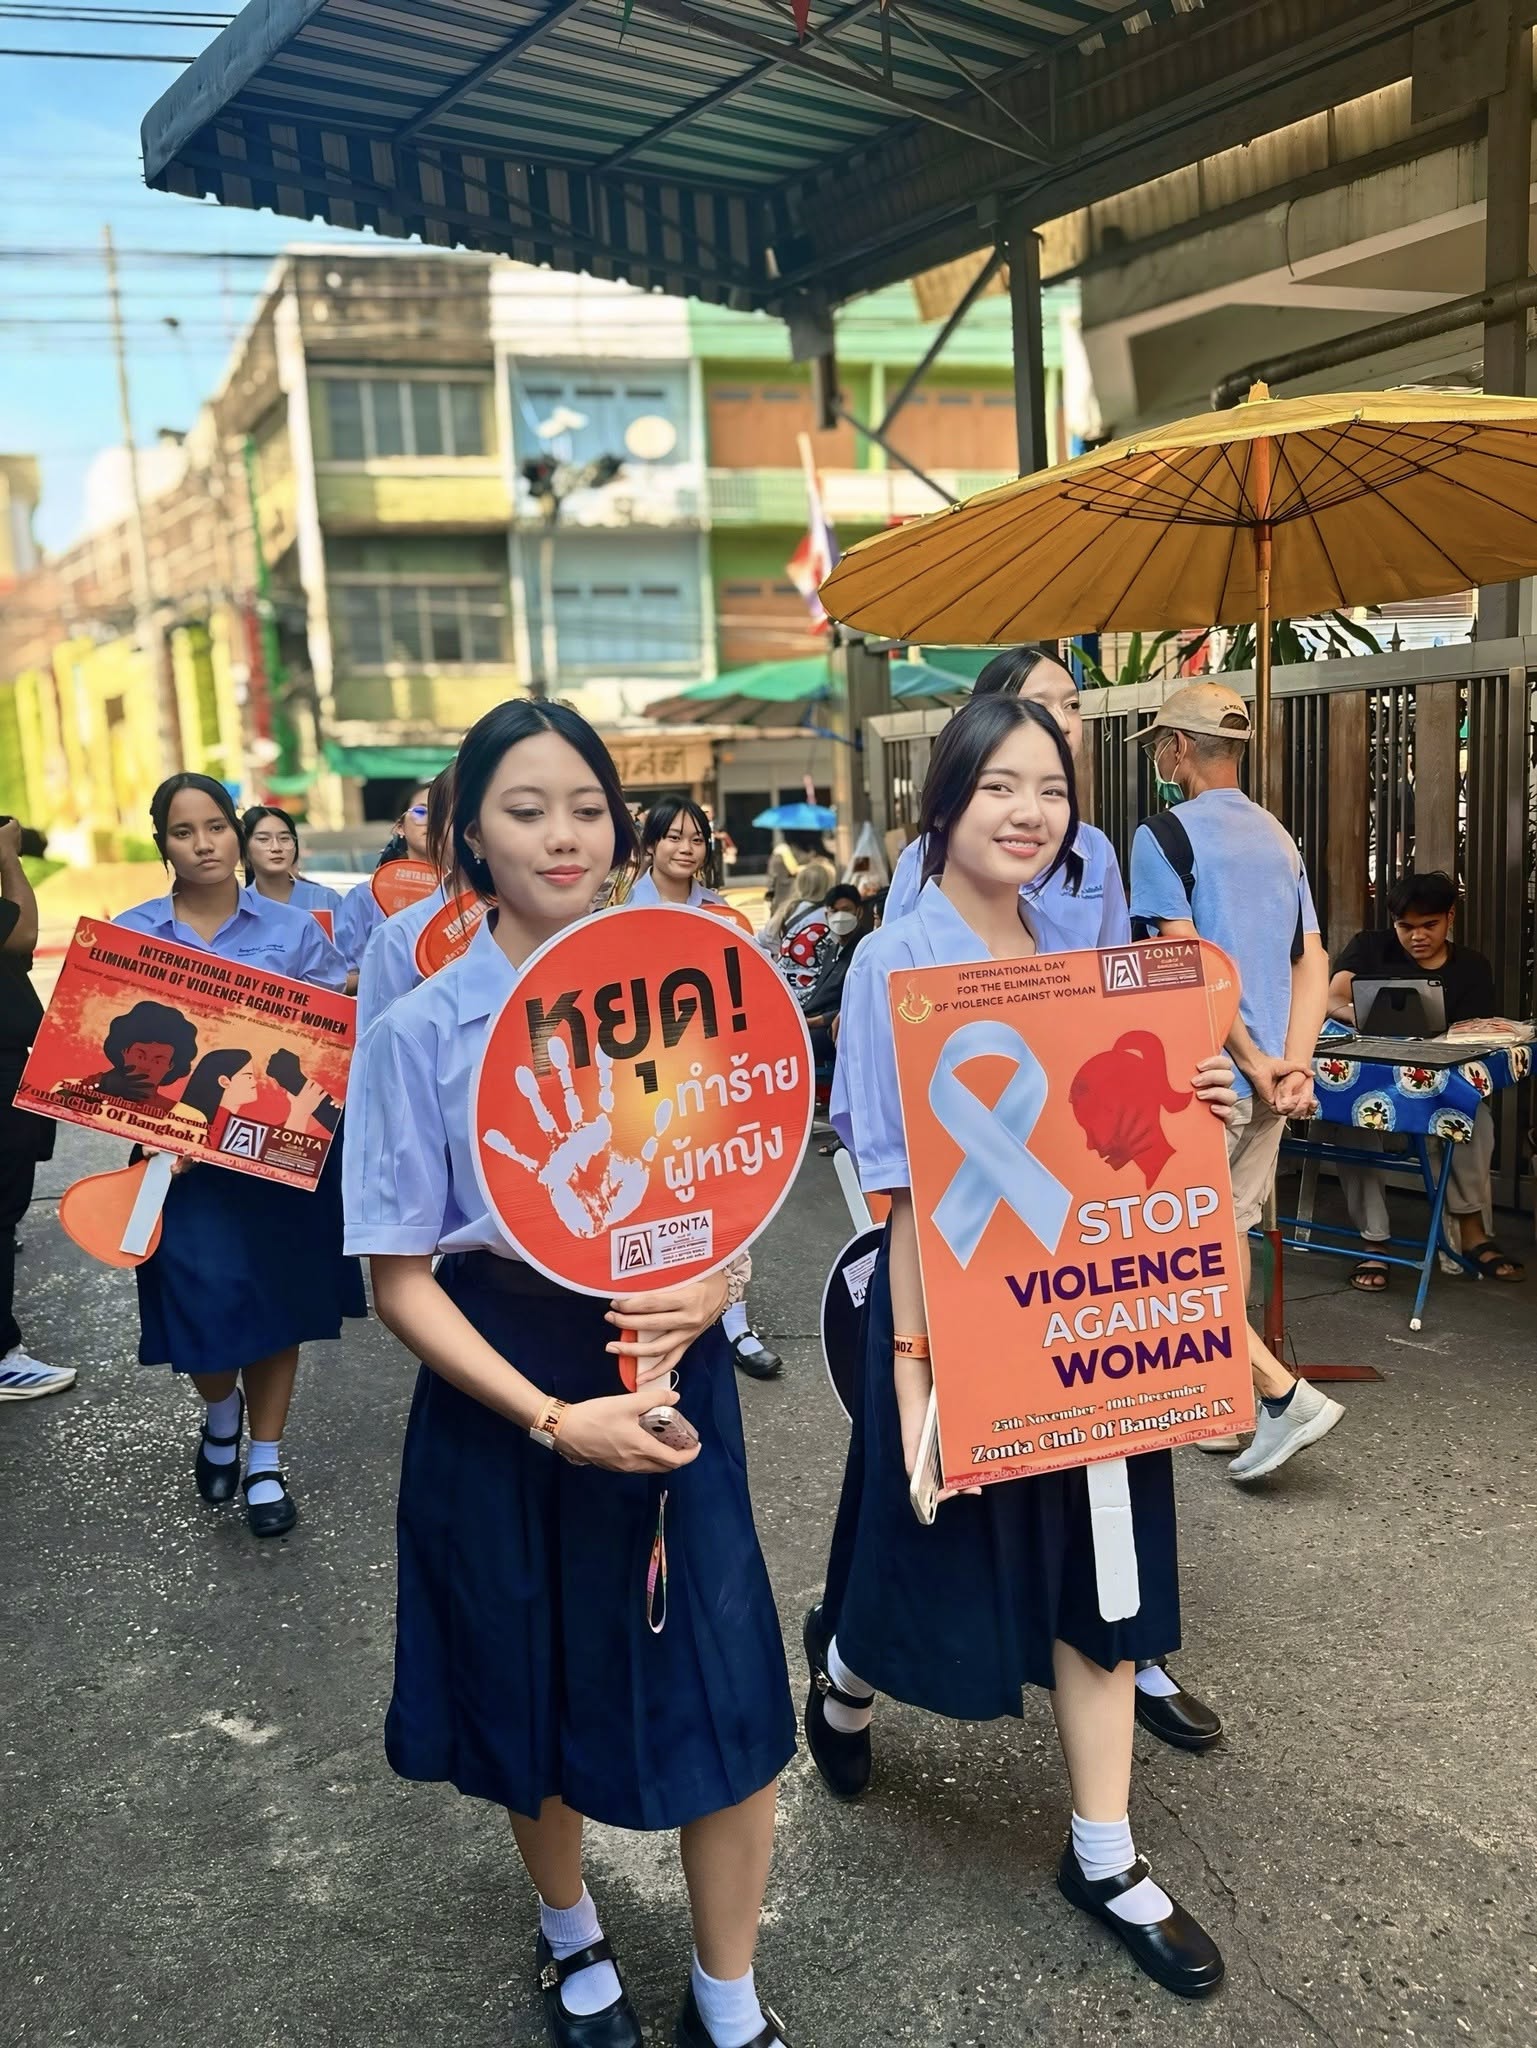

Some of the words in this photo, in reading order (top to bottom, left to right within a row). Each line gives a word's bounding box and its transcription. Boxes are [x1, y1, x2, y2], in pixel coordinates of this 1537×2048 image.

[138, 945, 232, 983] INTERNATIONAL
[234, 974, 260, 991] DAY
[261, 982, 285, 999] FOR
[287, 989, 311, 1007] THE
[958, 964, 1042, 981] INTERNATIONAL
[1044, 961, 1066, 972] DAY
[1144, 945, 1194, 960] ZONTA
[89, 947, 168, 981] ELIMINATION
[168, 971, 186, 986] OF
[186, 976, 245, 1004] VIOLENCE
[245, 995, 300, 1021] AGAINST
[300, 1011, 348, 1035] WOMEN
[934, 1002, 949, 1013] OF
[950, 996, 1004, 1011] VIOLENCE
[1006, 990, 1051, 1004] AGAINST
[1053, 985, 1097, 999] WOMAN
[957, 985, 979, 996] FOR
[981, 982, 1001, 993] THE
[1004, 974, 1072, 990] ELIMINATION
[524, 946, 748, 1095] หยุด!
[18, 1082, 65, 1107] Zonta
[67, 1095, 104, 1116] Club
[106, 1107, 124, 1122] Of
[125, 1114, 195, 1144] Bangkok
[676, 1052, 799, 1118] ทำร้าย
[271, 1128, 323, 1151] ZONTA
[663, 1122, 784, 1203] ผู้หญิง
[658, 1216, 710, 1238] ZONTA
[1077, 1185, 1220, 1246] STOP
[1005, 1241, 1226, 1309] VIOLENCE
[1042, 1284, 1230, 1350] AGAINST
[1051, 1325, 1233, 1389] WOMAN
[971, 1439, 1035, 1465] Zonta
[1038, 1427, 1088, 1451] Club
[1091, 1420, 1116, 1441] Of
[1119, 1403, 1209, 1436] Bangkok
[1212, 1397, 1235, 1417] IX
[992, 1416, 1024, 1433] 25th
[1024, 1404, 1097, 1428] November
[1106, 1395, 1136, 1412] 10th
[1138, 1383, 1208, 1405] December
[1174, 1427, 1212, 1445] WITHOUT
